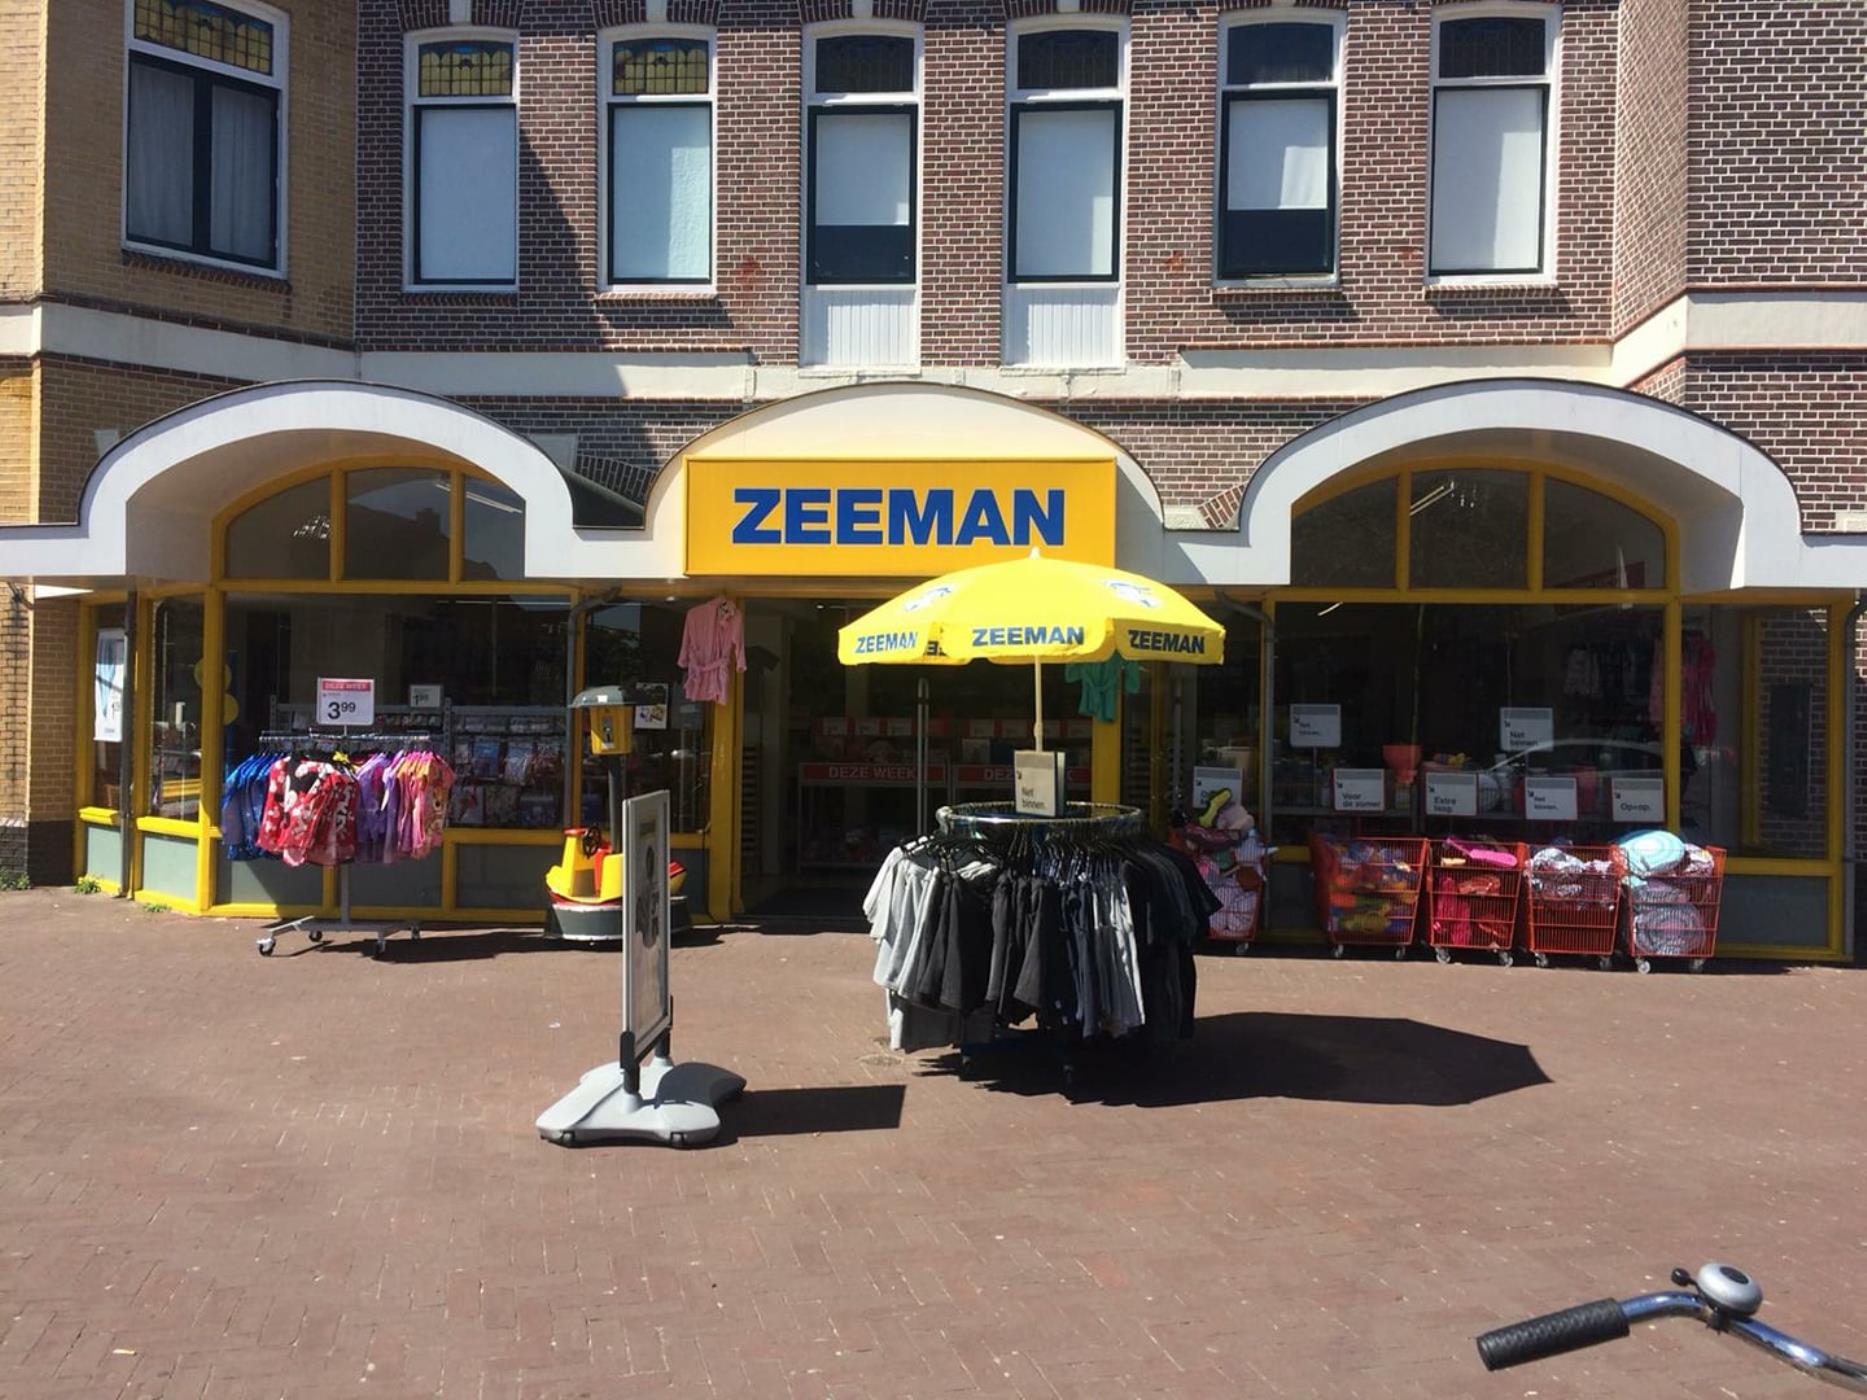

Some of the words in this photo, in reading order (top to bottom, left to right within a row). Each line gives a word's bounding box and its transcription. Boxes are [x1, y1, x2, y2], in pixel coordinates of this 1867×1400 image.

[732, 488, 1065, 546] ZEEMAN
[855, 631, 918, 654] ZEEMAN
[972, 626, 1085, 648] ZEEMAN
[1128, 629, 1205, 655] ZEEMAN
[828, 766, 869, 780] DEZE
[873, 766, 916, 780] WEEK
[984, 767, 1014, 781] DEZ
